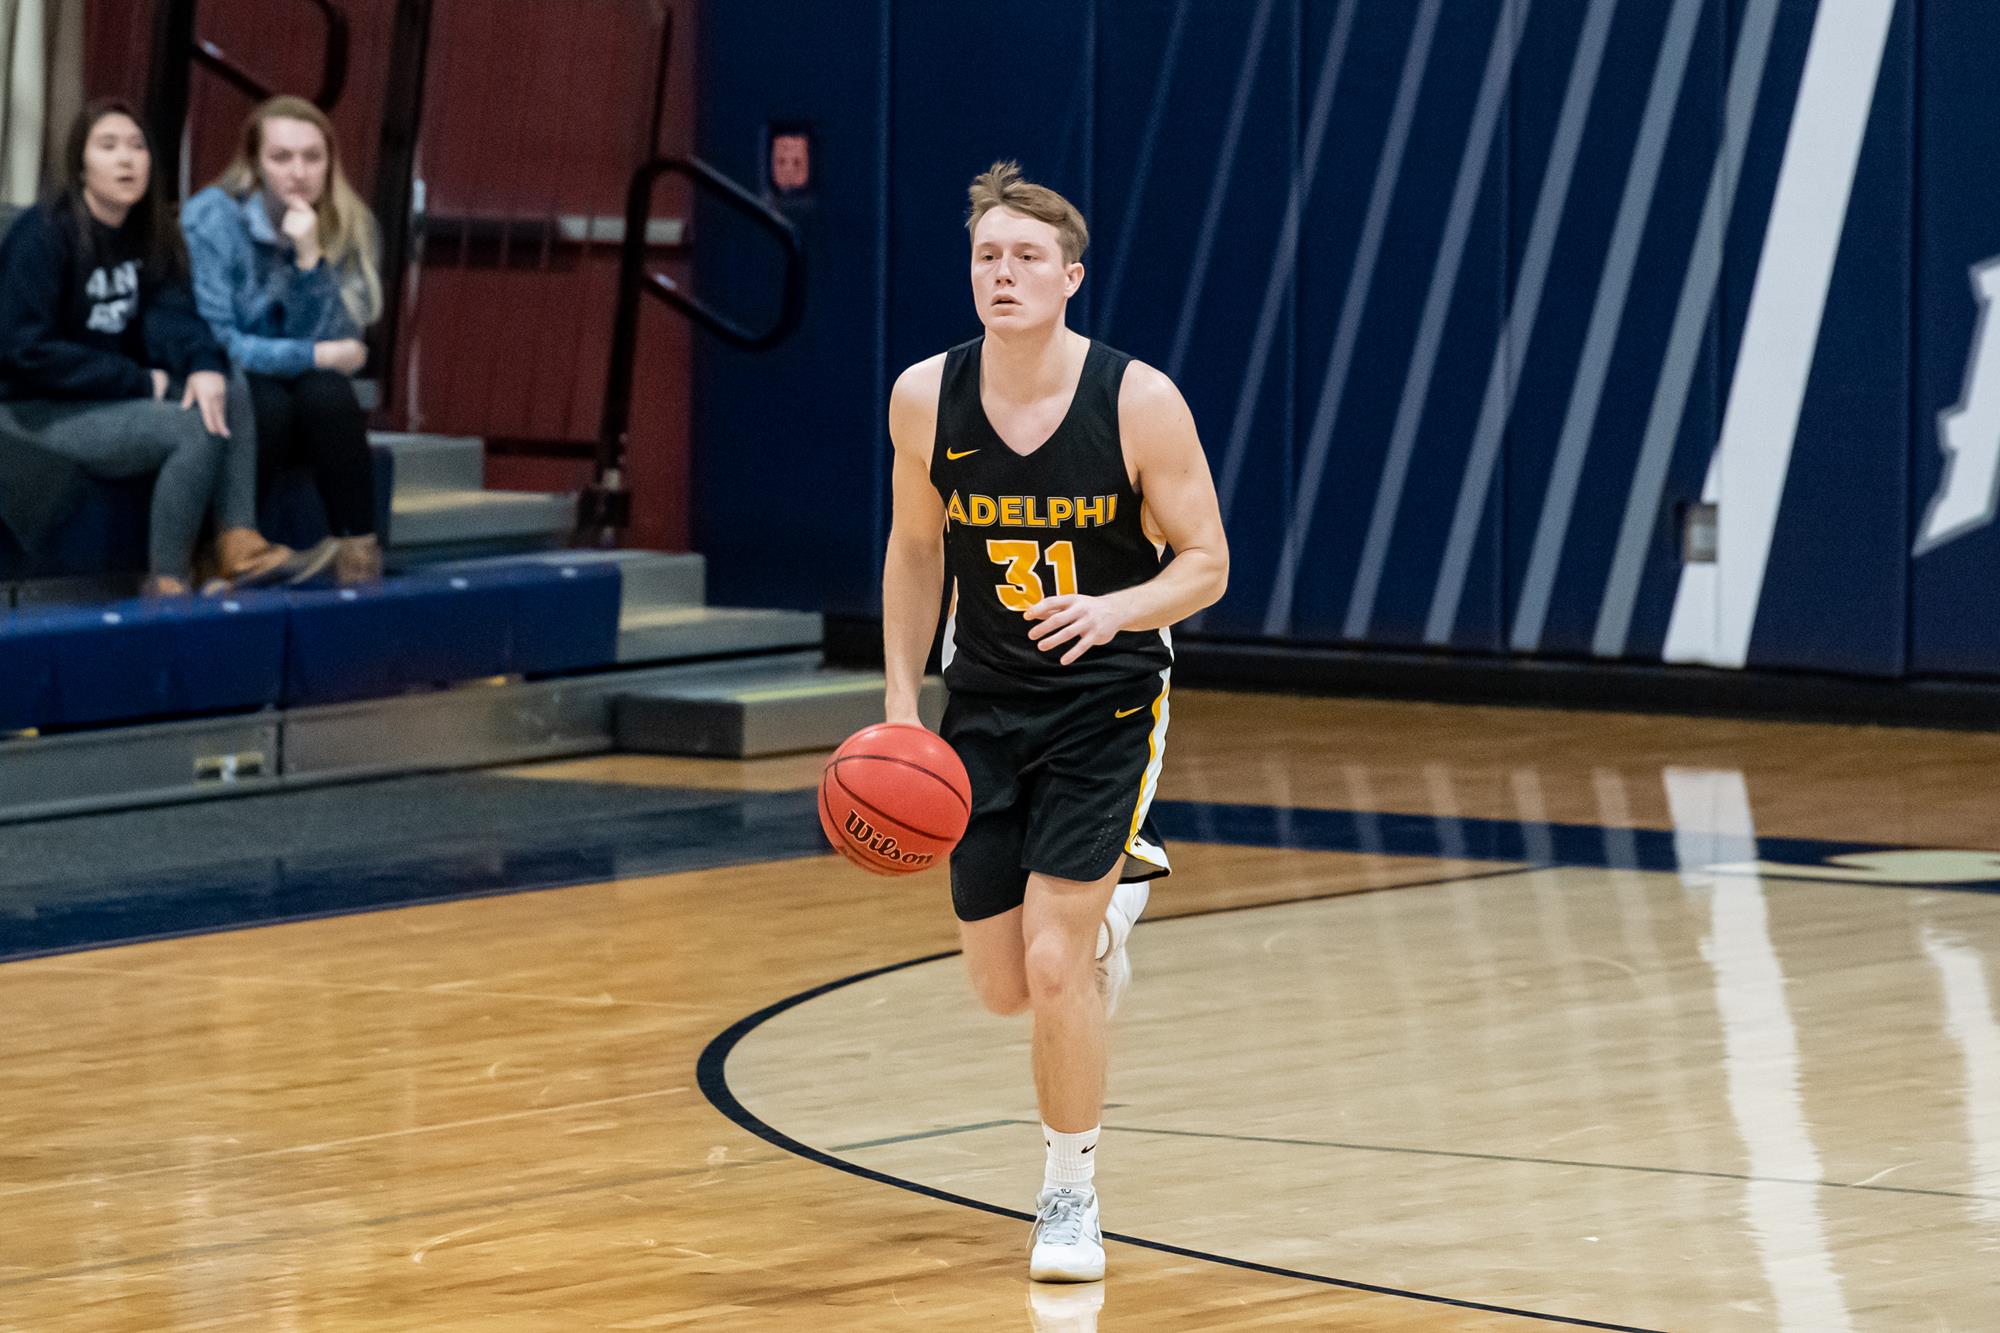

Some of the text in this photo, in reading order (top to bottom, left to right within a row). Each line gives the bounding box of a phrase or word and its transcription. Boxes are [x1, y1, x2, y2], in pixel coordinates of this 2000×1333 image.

[948, 489, 1118, 528] ADELPHI
[986, 539, 1078, 612] 31
[844, 809, 934, 865] Wilson
